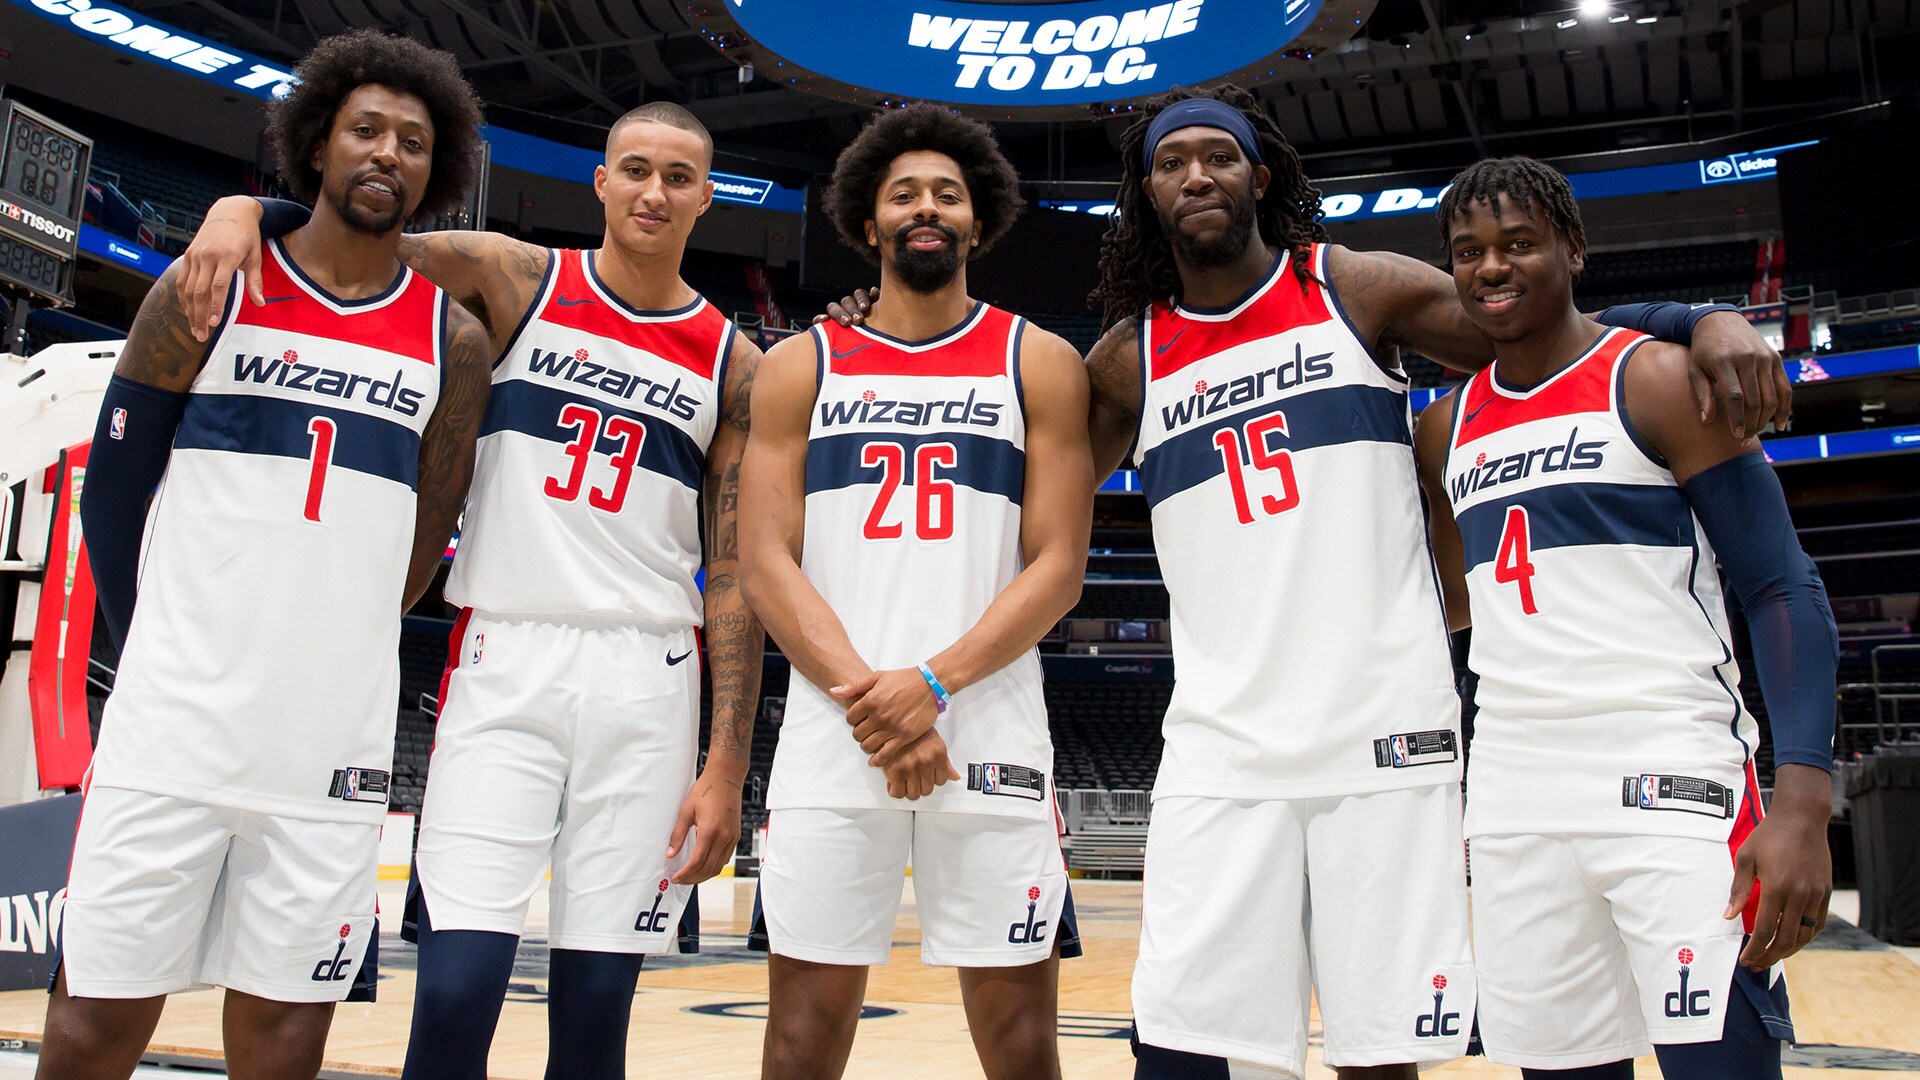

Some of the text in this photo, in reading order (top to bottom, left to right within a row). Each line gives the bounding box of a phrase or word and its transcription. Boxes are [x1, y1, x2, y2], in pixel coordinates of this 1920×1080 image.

[908, 0, 1202, 54] WELCOME
[233, 64, 303, 100] T
[955, 46, 1158, 91] TO D.C.
[21, 209, 75, 243] TISSOT
[1302, 184, 1454, 218] O D.
[234, 349, 427, 418] wizards
[528, 348, 703, 422] wizards
[821, 388, 1006, 427] wizards
[1162, 342, 1335, 432] wizards
[302, 417, 336, 524] 1
[542, 404, 647, 515] 33
[1214, 412, 1302, 527] 15
[1452, 426, 1610, 505] wizards
[861, 443, 958, 542] 26
[1494, 506, 1541, 616] 4
[635, 889, 670, 933] dc
[1008, 900, 1047, 945] dc
[311, 938, 353, 983] dc
[1415, 990, 1460, 1038] dc
[1664, 965, 1711, 1018] dc
